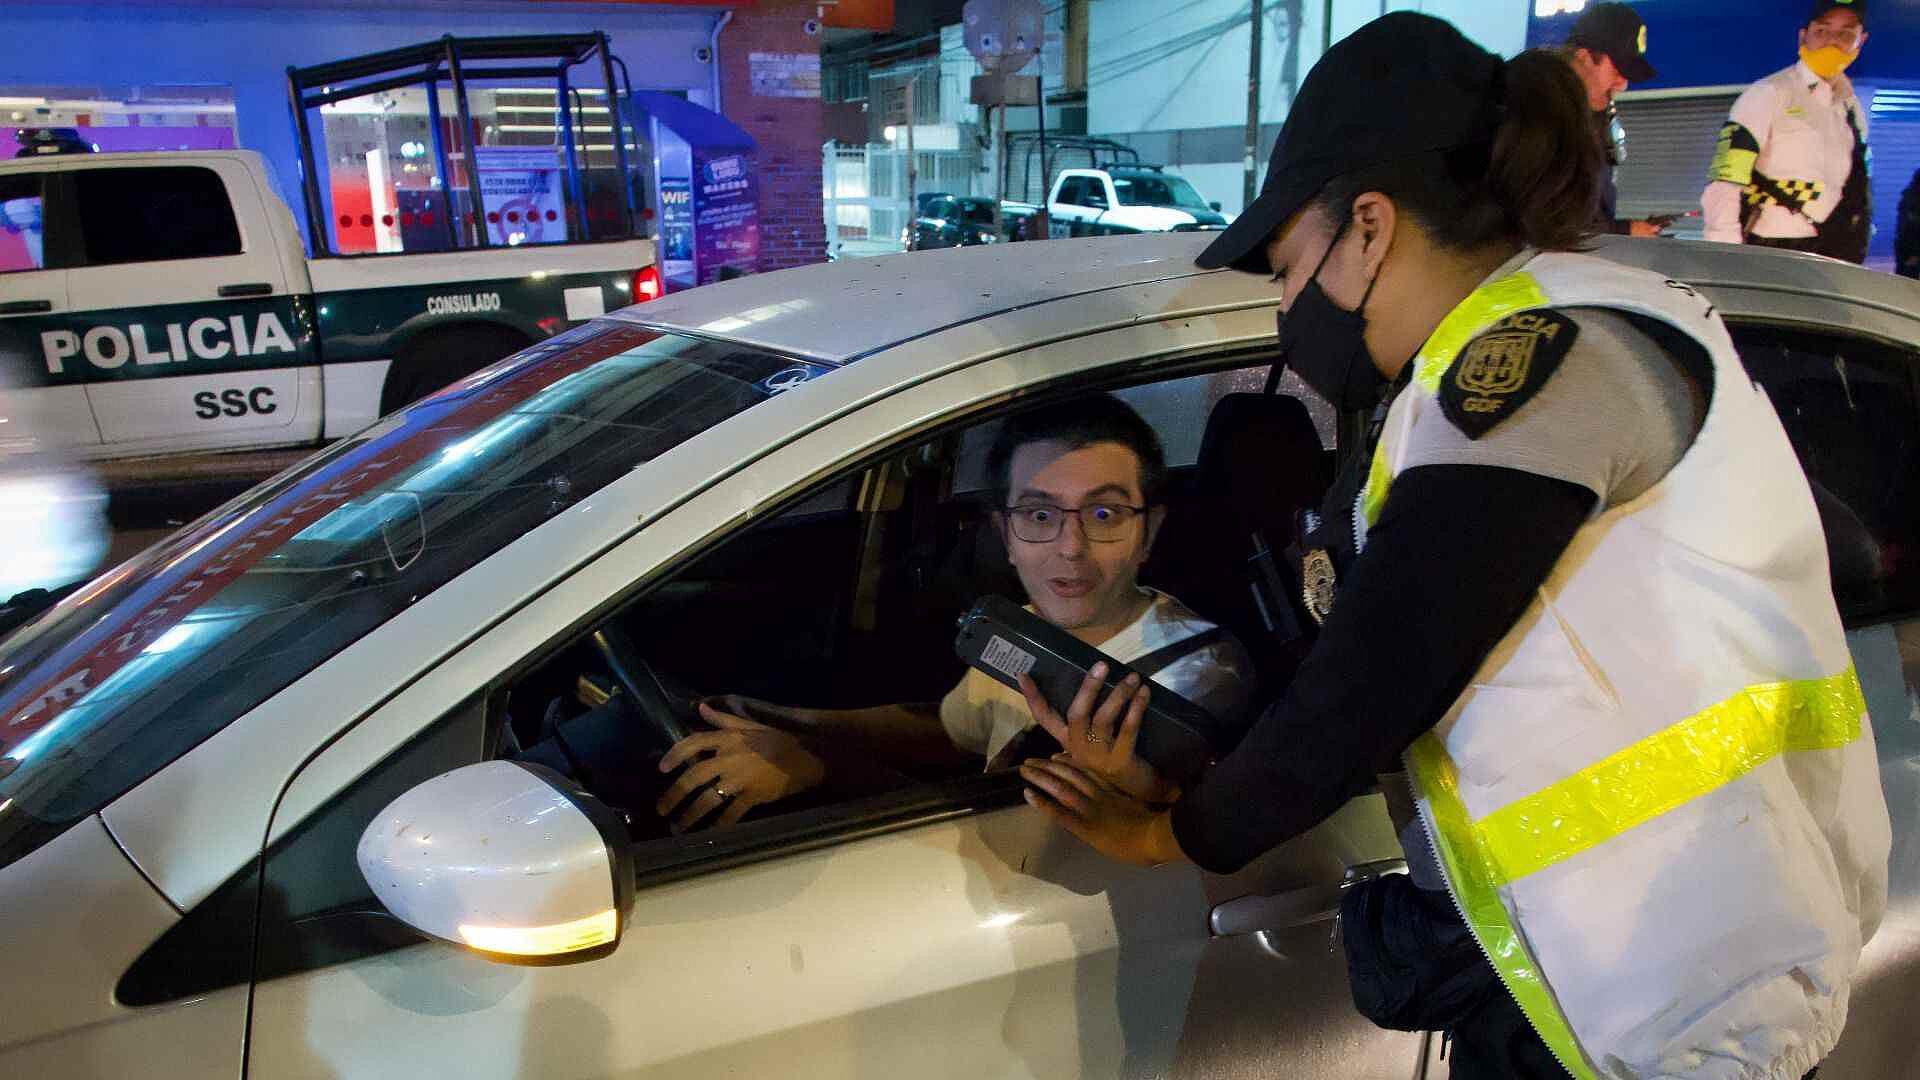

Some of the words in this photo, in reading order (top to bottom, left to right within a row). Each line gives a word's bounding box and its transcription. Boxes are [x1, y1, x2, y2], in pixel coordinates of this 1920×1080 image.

[426, 292, 500, 315] CONSULADO
[41, 312, 296, 374] POLICIA
[194, 386, 277, 420] SSC
